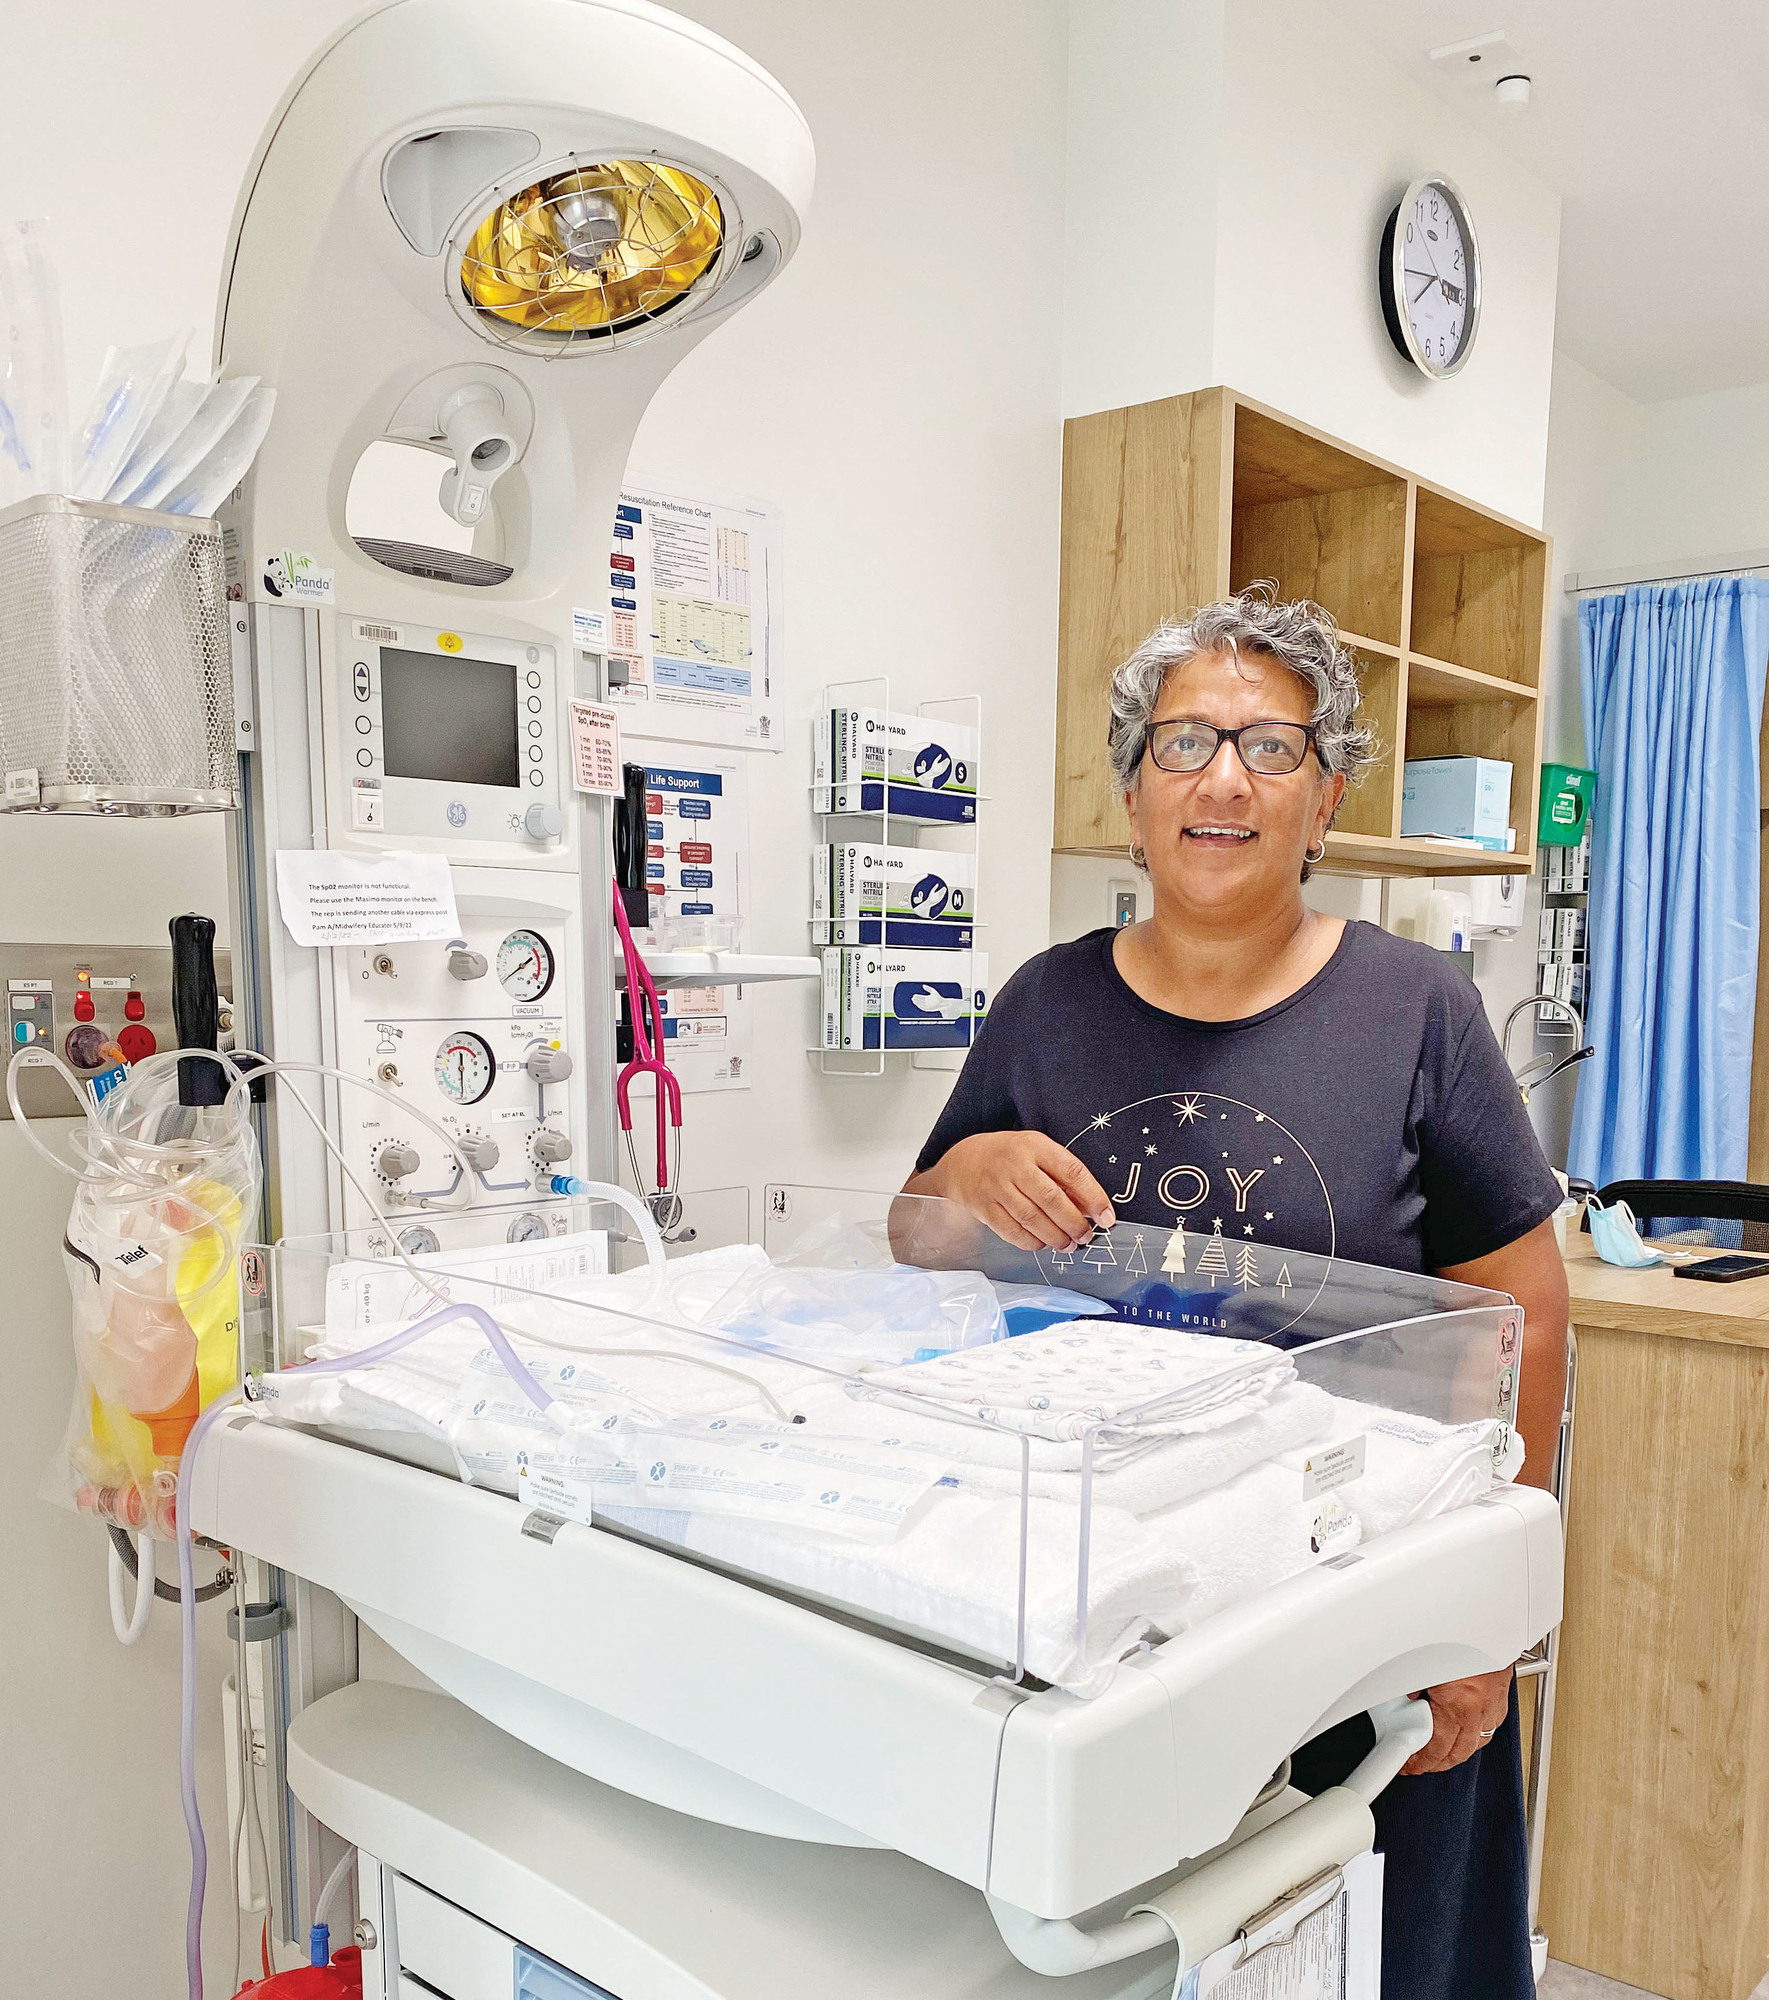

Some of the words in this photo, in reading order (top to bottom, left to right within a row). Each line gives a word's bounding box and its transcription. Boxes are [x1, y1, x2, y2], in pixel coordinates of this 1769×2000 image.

[1416, 201, 1424, 222] 11
[1430, 200, 1438, 222] 12
[1406, 222, 1413, 243] 0
[1446, 220, 1449, 239] 1
[1454, 250, 1460, 270] 2
[1450, 320, 1456, 337] 4
[1425, 338, 1431, 358] 6
[1440, 337, 1445, 356] 5
[619, 492, 660, 508] Resuscitation
[662, 501, 694, 515] Reference
[694, 508, 712, 520] Chart
[296, 576, 329, 590] Panda
[296, 587, 324, 597] Warmer
[600, 721, 611, 730] birth
[876, 724, 906, 736] HAYARD
[866, 746, 893, 756] STERLIG
[866, 754, 885, 762] NITRIL
[958, 766, 964, 780] S
[1405, 768, 1431, 776] urpose
[1432, 766, 1452, 775] Towel
[650, 774, 666, 786] Life
[668, 776, 700, 789] Support
[874, 858, 904, 869] HAYARD
[863, 882, 889, 890] STERLIG
[954, 894, 961, 906] M
[328, 923, 367, 931] A/Midwifery
[877, 964, 905, 972] HLYARD
[977, 994, 983, 1007] L
[1112, 1162, 1265, 1212] JOY
[364, 1296, 370, 1306] 40
[1123, 1305, 1138, 1317] TO
[1148, 1308, 1172, 1322] THE
[1182, 1313, 1228, 1329] WORLD
[1328, 1515, 1352, 1534] Panda
